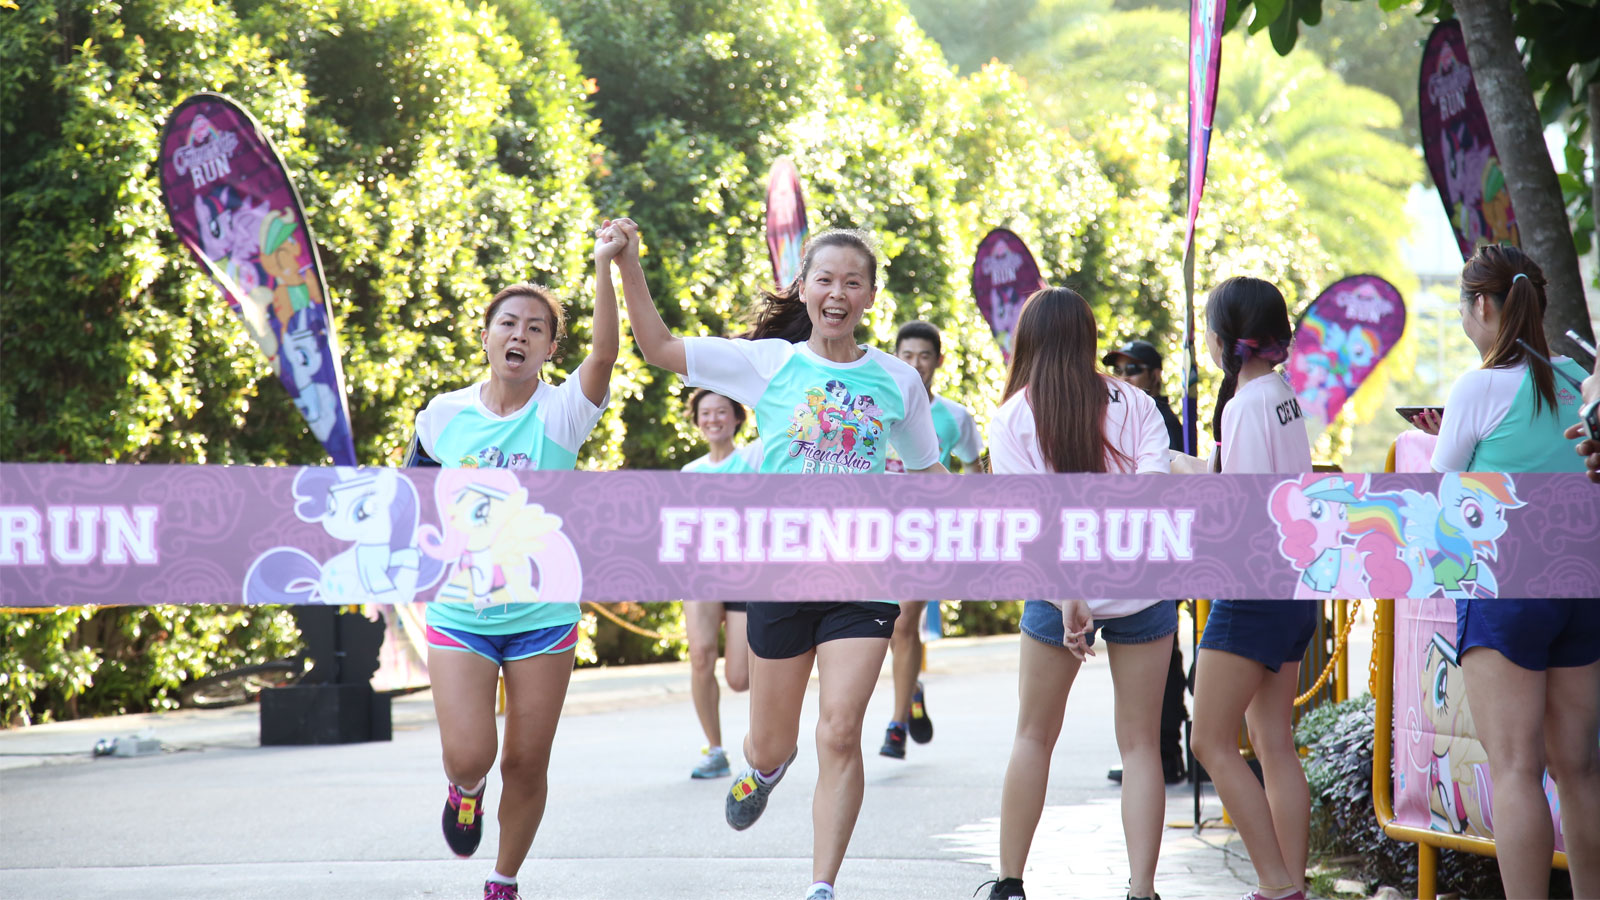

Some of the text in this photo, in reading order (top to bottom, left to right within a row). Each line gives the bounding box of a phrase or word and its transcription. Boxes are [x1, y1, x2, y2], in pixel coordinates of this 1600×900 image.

[191, 153, 231, 189] RUN
[992, 267, 1016, 285] RUN
[1276, 398, 1302, 425] CEW
[789, 439, 871, 472] Friendship
[0, 505, 158, 565] RUN
[659, 507, 1041, 563] FRIENDSHIP
[1059, 508, 1196, 562] RUN
